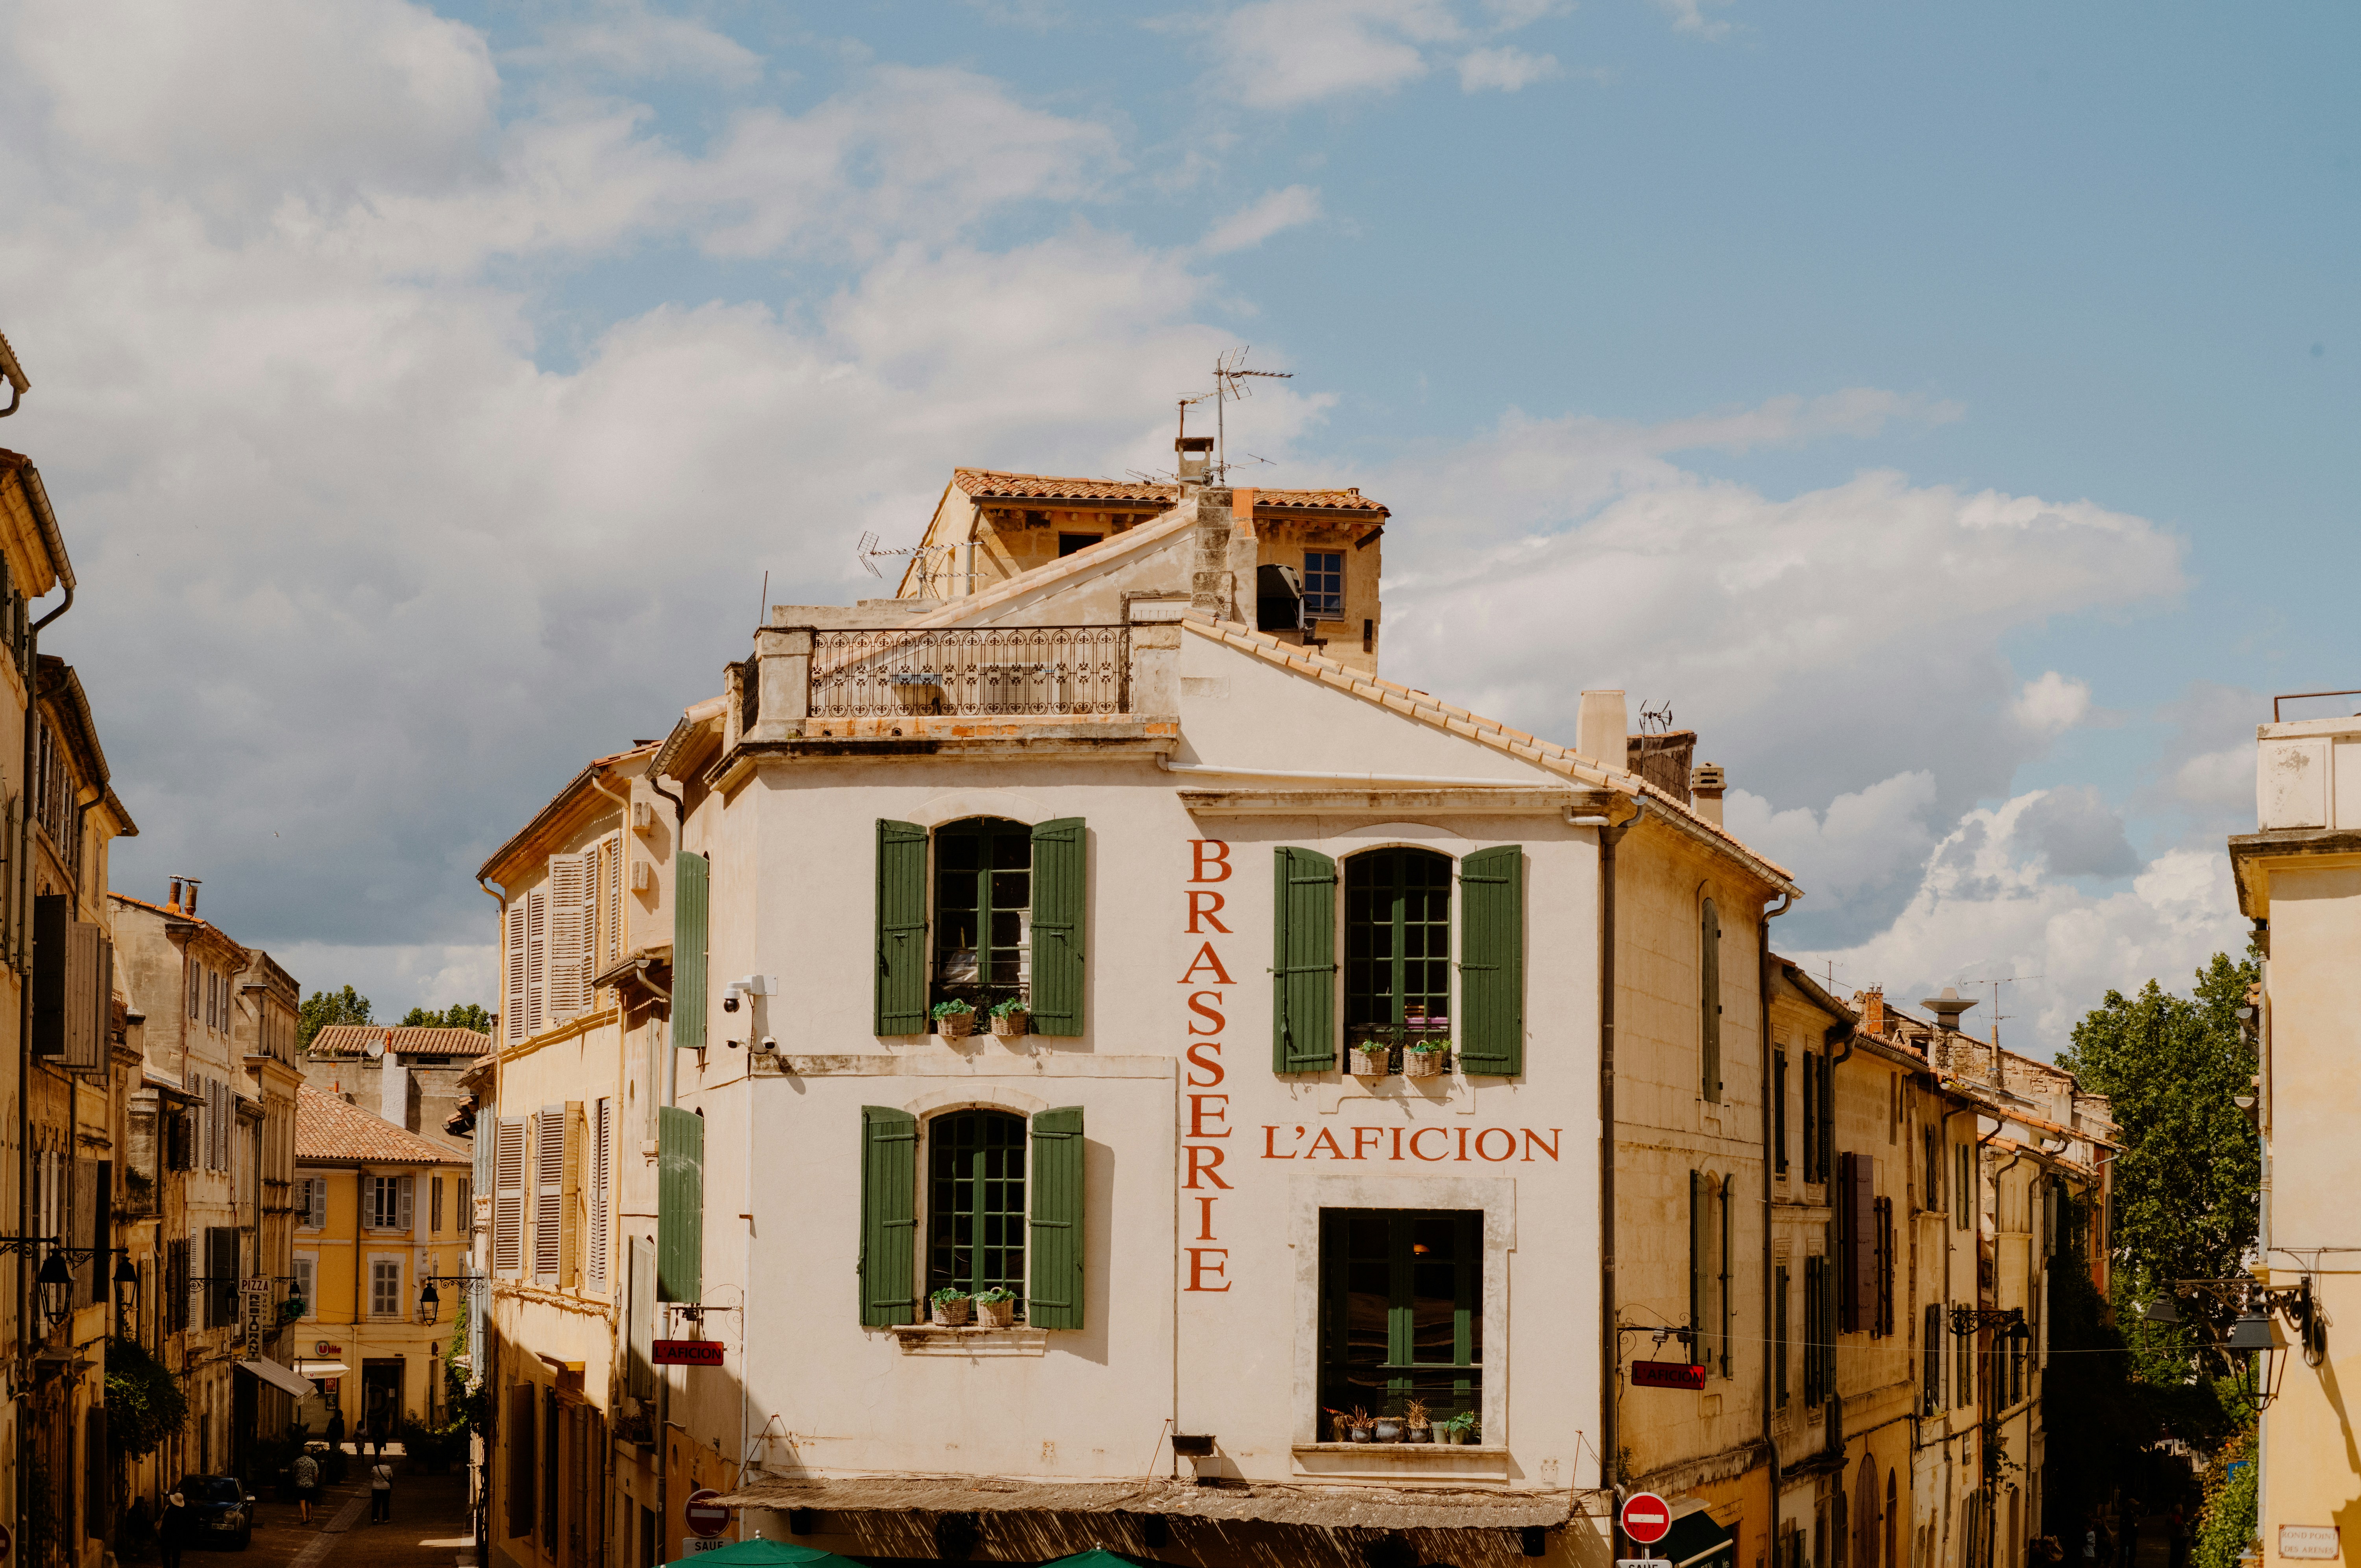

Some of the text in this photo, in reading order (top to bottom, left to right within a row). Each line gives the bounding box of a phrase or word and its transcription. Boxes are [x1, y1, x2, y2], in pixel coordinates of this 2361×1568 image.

[1177, 839, 1238, 1292] BRASSERIE
[1261, 1125, 1563, 1162] L'AFICION
[242, 1280, 268, 1291] PIZZA
[248, 1294, 260, 1357] RESTAURANT
[319, 1345, 342, 1354] Utile
[655, 1347, 721, 1359] L'AFICION
[1634, 1368, 1703, 1383] L'AFICION
[695, 1541, 724, 1551] SAUF
